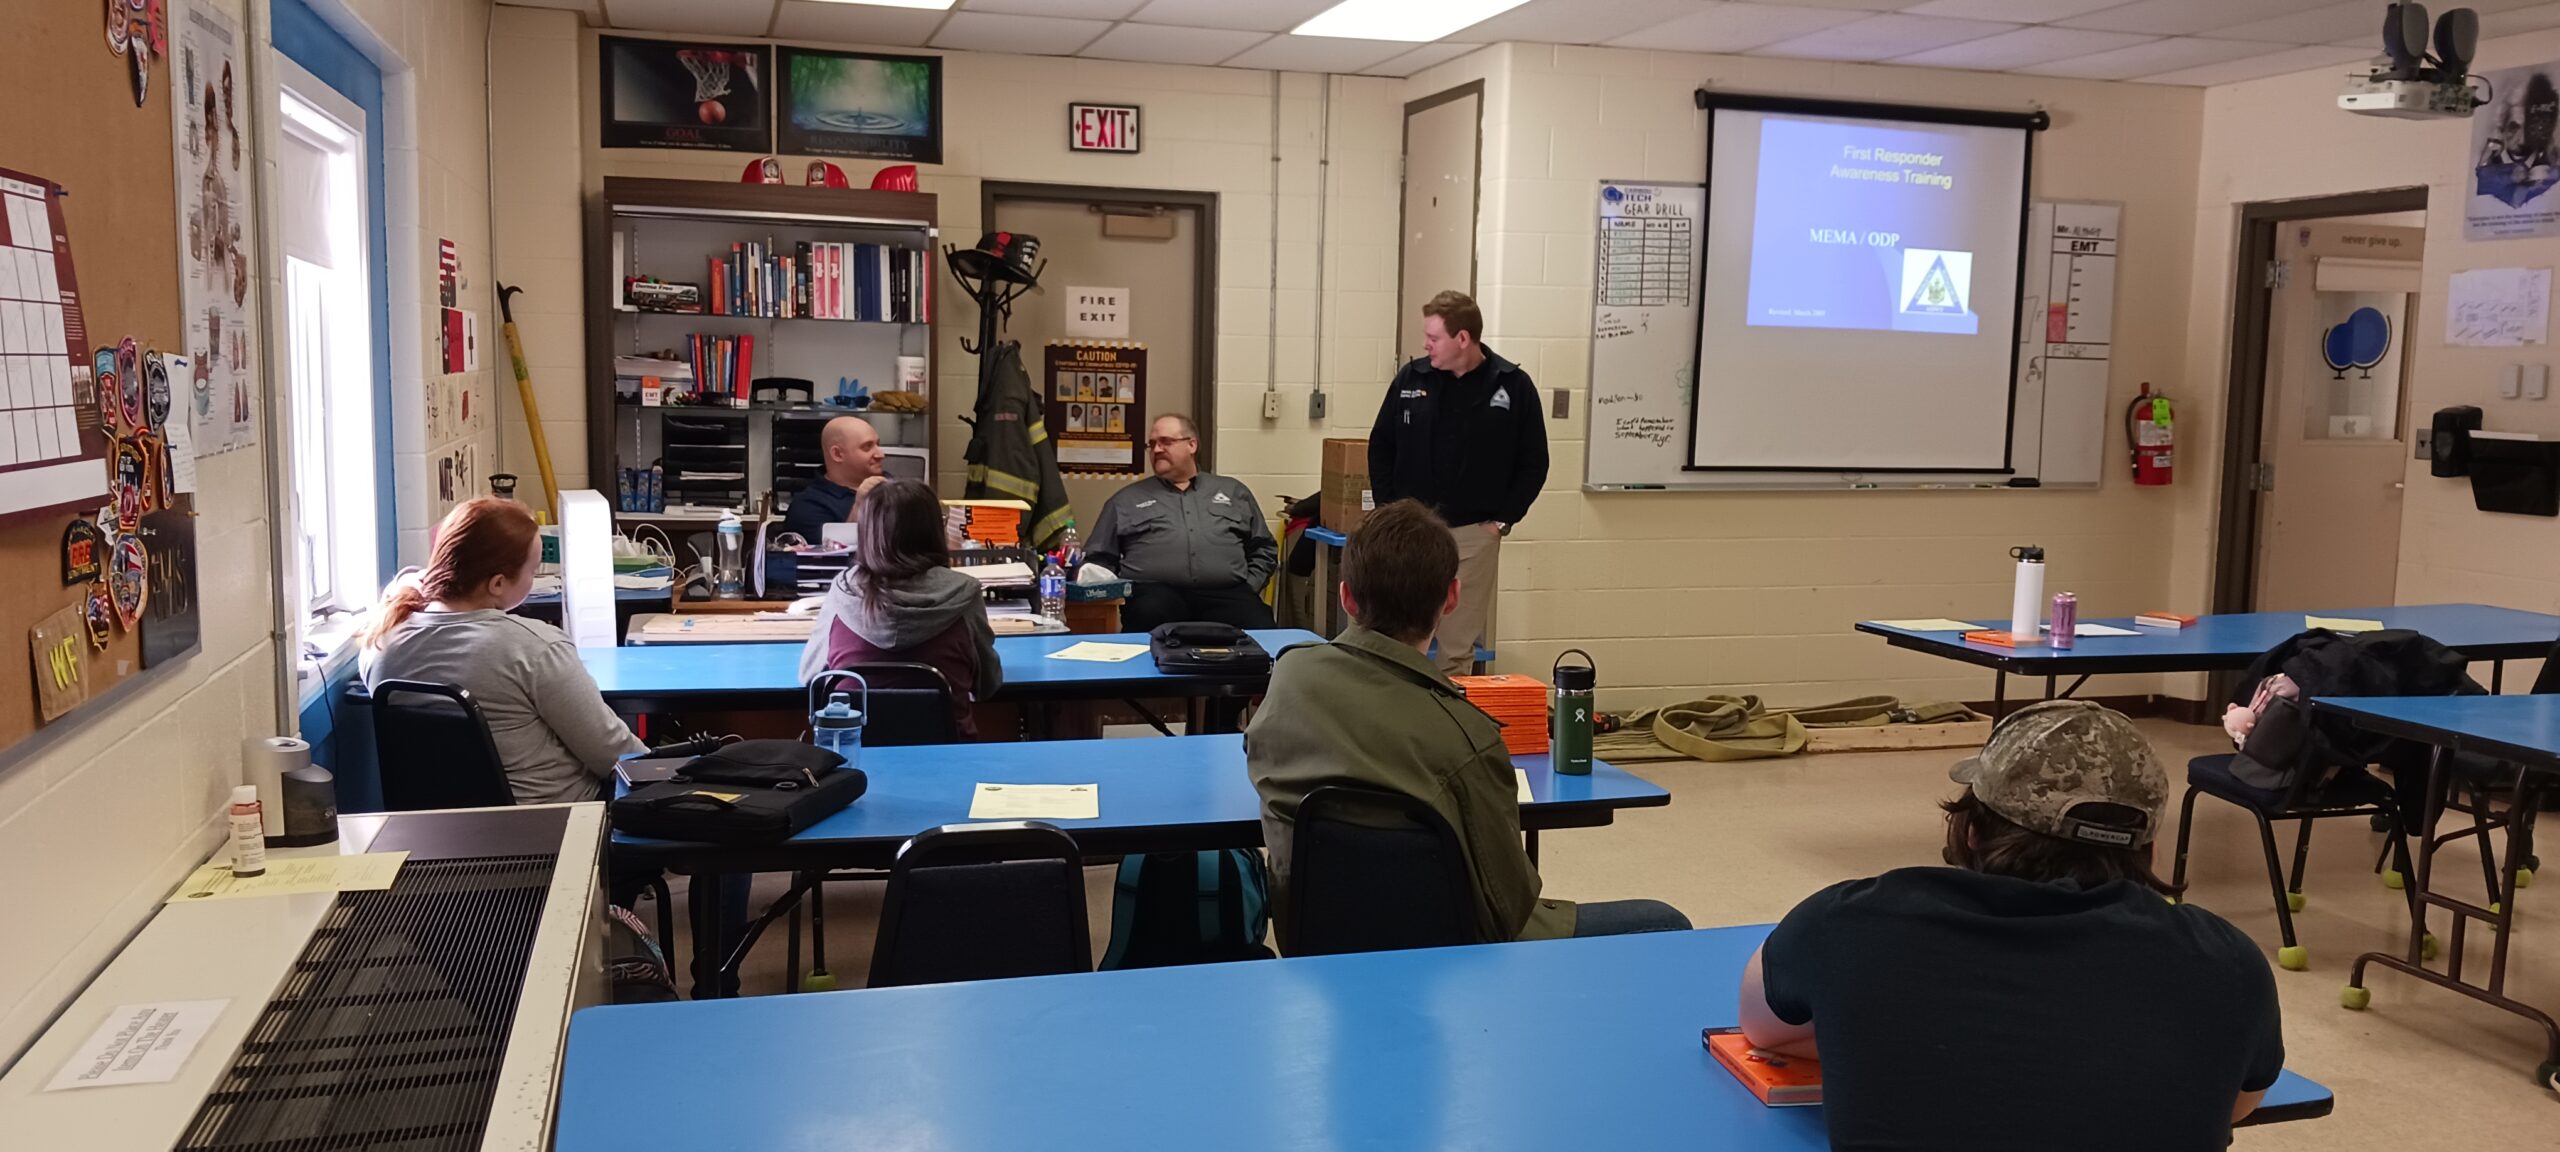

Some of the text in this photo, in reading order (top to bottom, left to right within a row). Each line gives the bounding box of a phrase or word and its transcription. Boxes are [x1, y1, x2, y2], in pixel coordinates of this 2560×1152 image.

[665, 127, 701, 140] GOAL
[1081, 108, 1130, 148] EXIT
[1843, 145, 1944, 166] First Responder
[1830, 165, 1953, 190] Awareness Training
[1625, 194, 1652, 202] TECH
[1624, 203, 1684, 217] GEAR DRILL
[1809, 228, 1857, 244] MEMA
[1867, 231, 1900, 247] ODP
[2341, 235, 2367, 245] never
[2368, 236, 2387, 248] give
[2071, 240, 2099, 252] EMT
[1080, 296, 1116, 306] FIRE
[1080, 313, 1117, 322] EXIT
[1076, 350, 1117, 362] CAUTION
